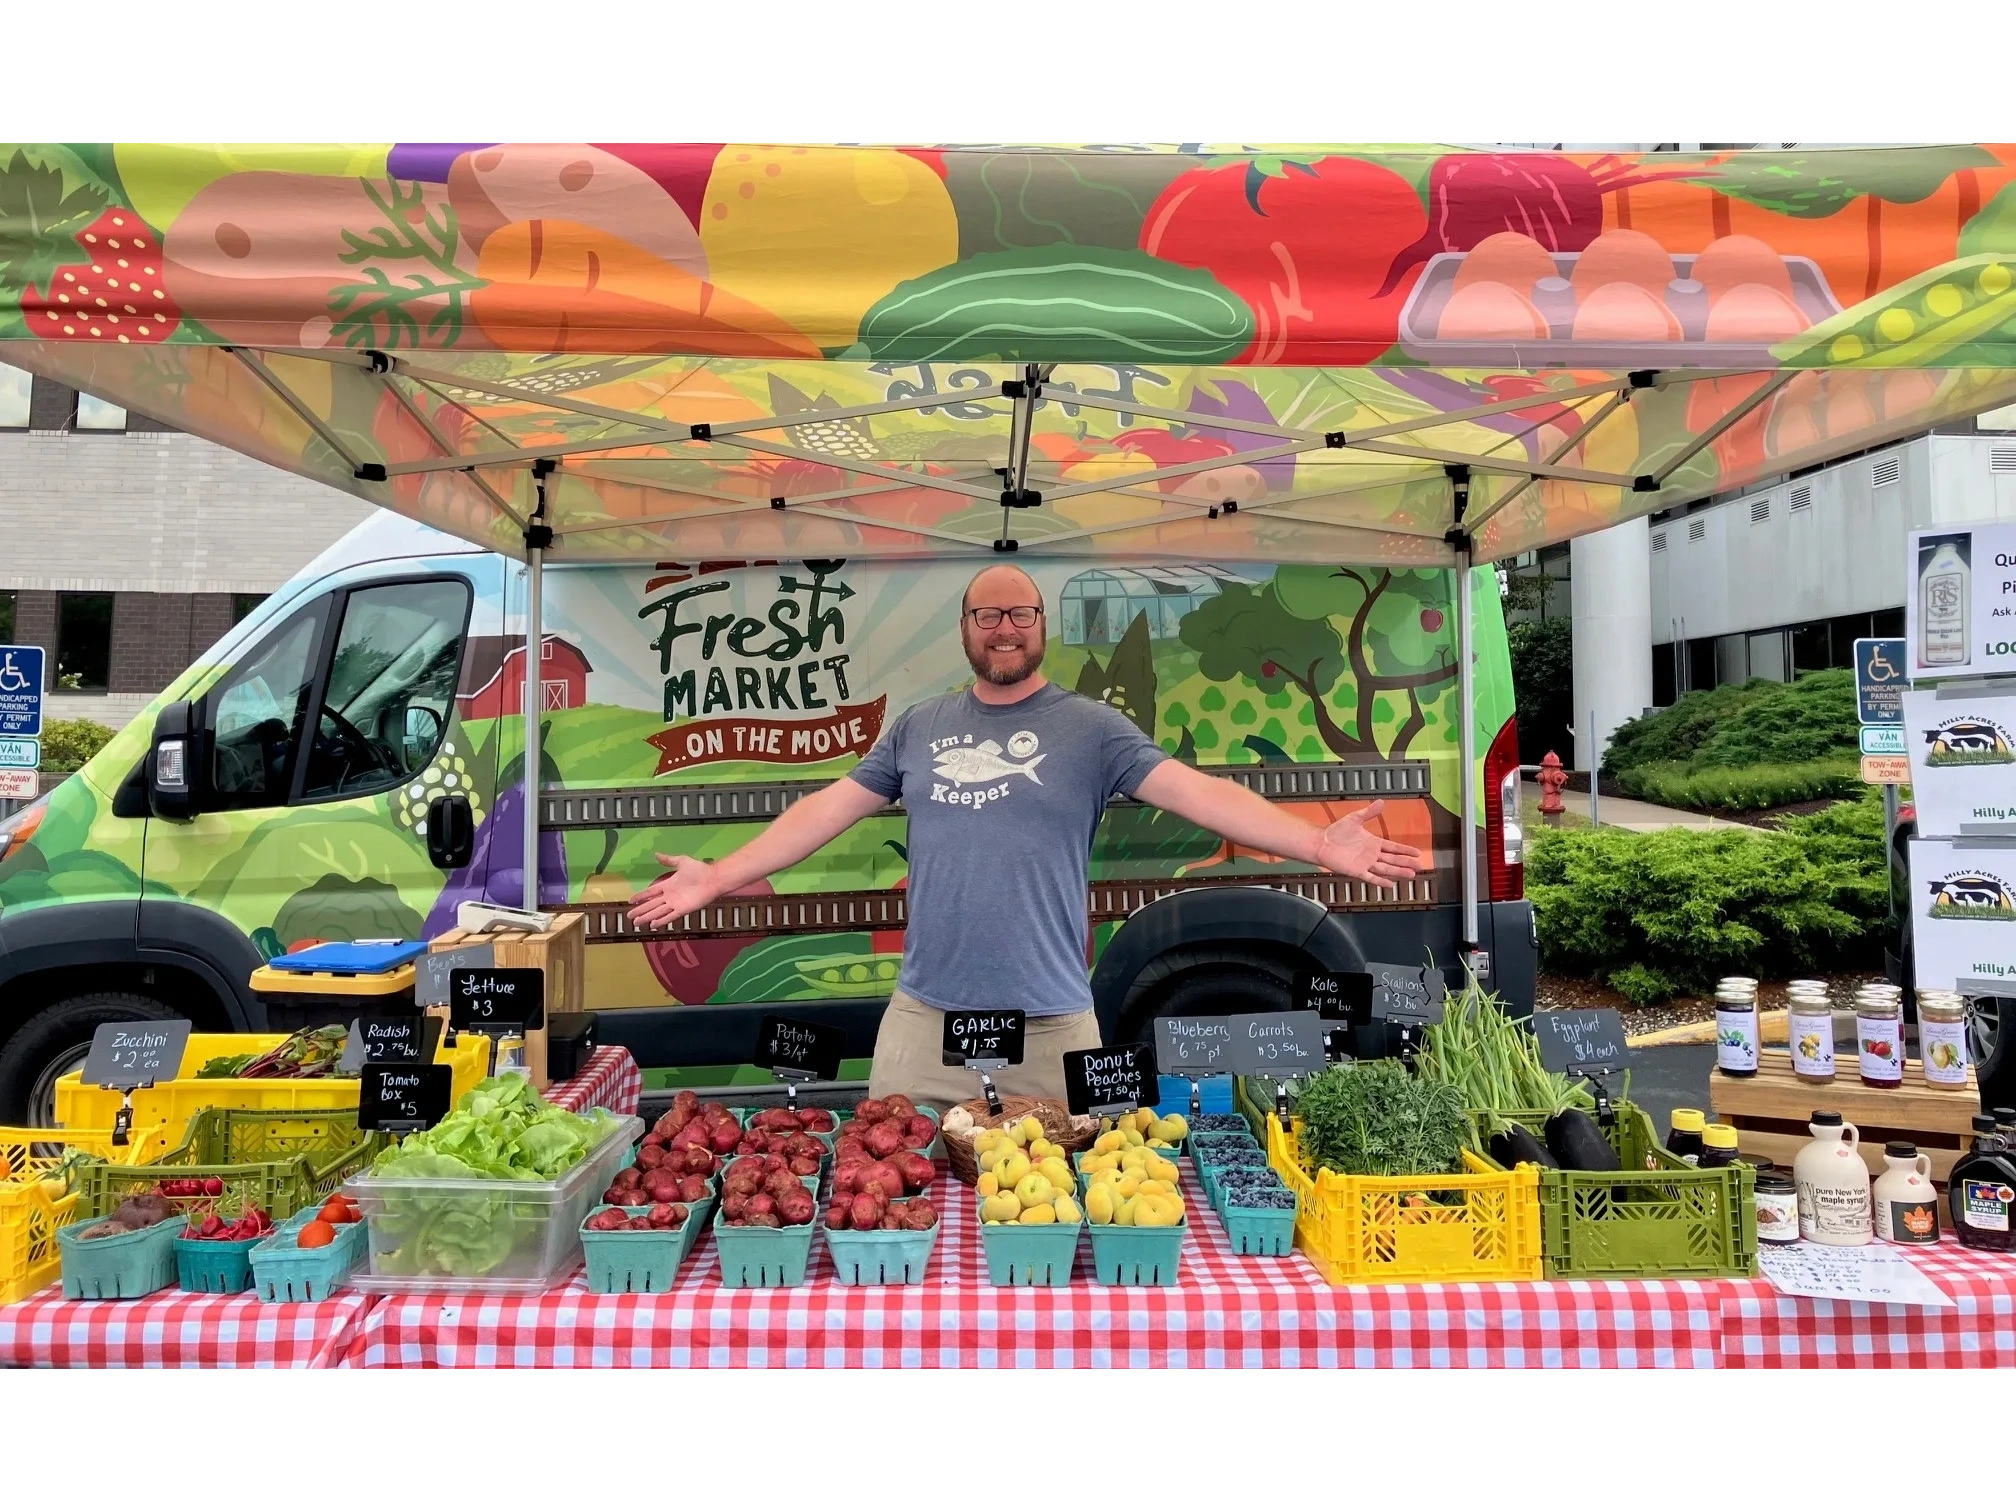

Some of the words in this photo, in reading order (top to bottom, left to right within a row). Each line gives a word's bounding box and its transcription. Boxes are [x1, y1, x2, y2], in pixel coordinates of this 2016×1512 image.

[1992, 607, 2012, 617] Ask
[638, 571, 846, 675] Fresh
[664, 654, 850, 722] MARKET
[6, 714, 32, 722] PERMIT
[1878, 710, 1896, 718] ONLY
[1938, 715, 1966, 728] HILLY
[1968, 715, 1996, 726] ACRES
[2, 722, 22, 730] ONLY
[732, 726, 784, 755] THE
[791, 716, 867, 756] MOVE
[928, 734, 960, 754] I'm
[963, 733, 974, 744] a
[1878, 732, 1898, 741] VAN
[0, 744, 22, 754] VAN
[1878, 770, 1902, 778] ZONE
[930, 781, 1010, 810] Keeper
[1972, 808, 2005, 820] Hilly
[1944, 869, 1972, 880] HILLY
[1974, 869, 2002, 883] ACRES
[1972, 963, 2004, 976] Hilly
[460, 974, 516, 996] Lettuce
[1310, 976, 1338, 993] Kale
[1381, 972, 1425, 993] Scallions
[368, 1024, 410, 1038] Radish
[776, 1023, 816, 1044] Potato
[952, 1016, 1016, 1036] GARLIC
[1168, 1020, 1231, 1042] Blueberry
[1248, 1020, 1294, 1038] Carrots
[1551, 1013, 1600, 1043] Eggplant
[111, 1031, 168, 1048] Zucchini
[1574, 1040, 1594, 1061] $4
[1596, 1042, 1620, 1058] each
[144, 1060, 160, 1069] ea
[1083, 1050, 1134, 1071] Donut
[380, 1072, 420, 1087] Tomato
[1084, 1068, 1142, 1086] Peaches
[1816, 1188, 1834, 1197] pure
[1836, 1188, 1852, 1196] New
[1821, 1196, 1845, 1205] maple
[1970, 1200, 2002, 1208] MAPLE
[1970, 1206, 2002, 1214] SYRUP
